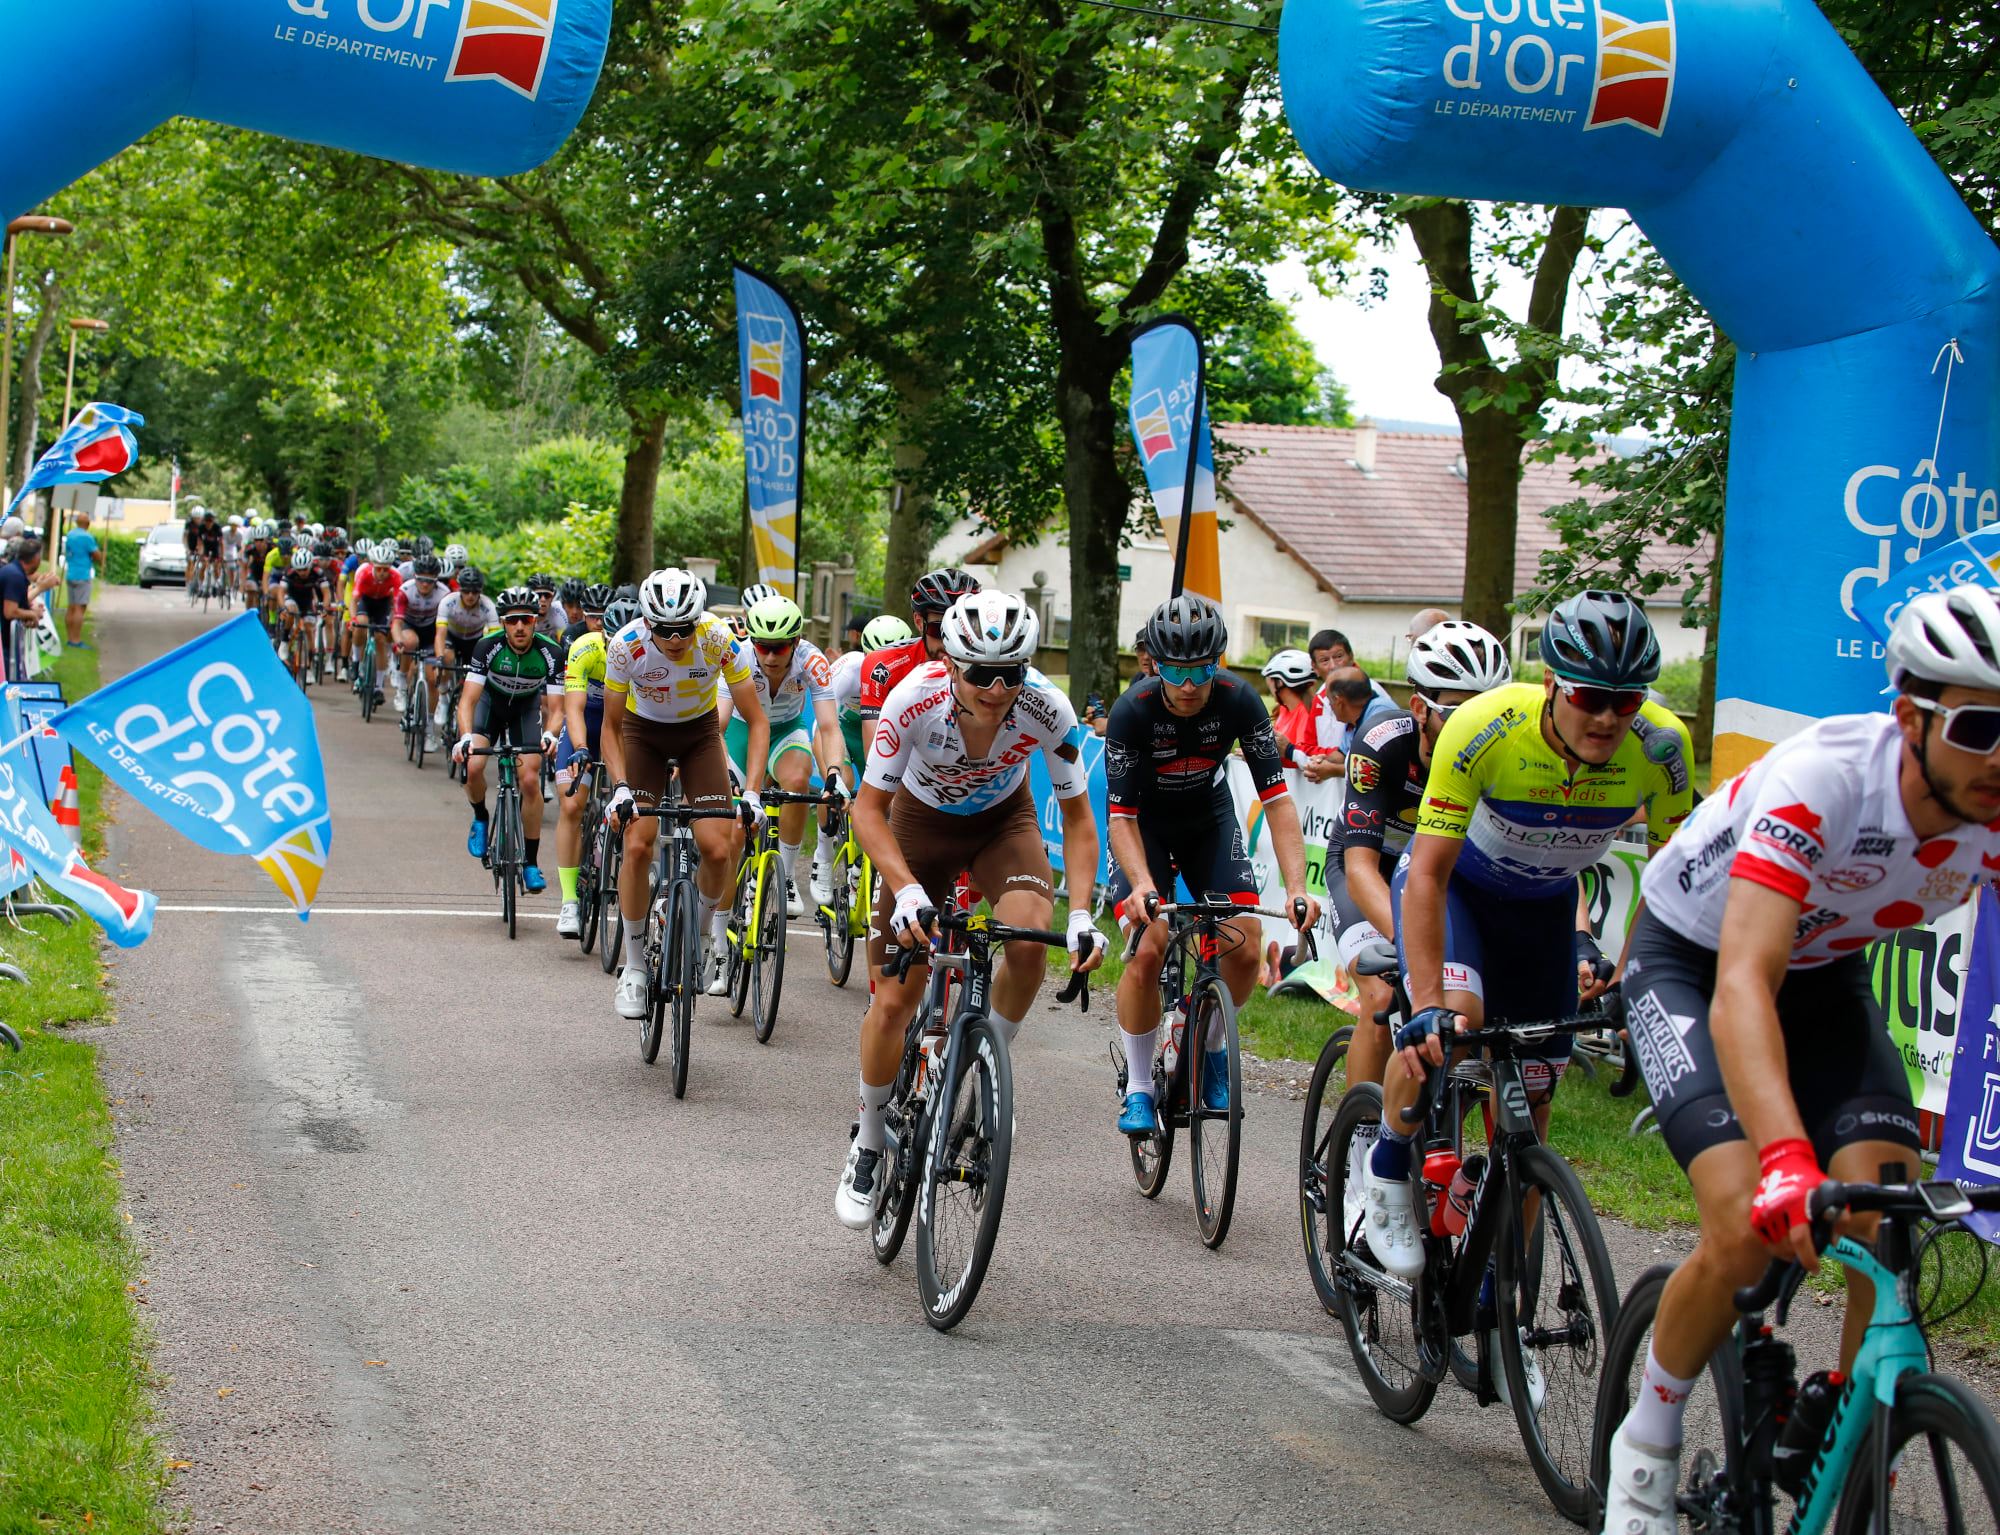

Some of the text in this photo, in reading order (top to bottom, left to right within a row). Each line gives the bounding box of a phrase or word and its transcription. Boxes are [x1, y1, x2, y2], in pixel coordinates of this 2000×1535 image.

[274, 24, 437, 71] LE DÉPARTEMENT
[1443, 23, 1585, 95] d'Or
[1434, 99, 1577, 124] LE DÉPARTEMENT
[1843, 459, 1998, 539] Côte
[1836, 639, 1863, 659] LE
[898, 687, 950, 728] CITROËN
[1018, 689, 1057, 720] AG2R LA
[86, 722, 113, 746] LE
[187, 661, 316, 824] Côte
[881, 772, 903, 784] BM
[1753, 817, 1824, 865] DORAS
[1636, 993, 1690, 1082] DEMEURES
